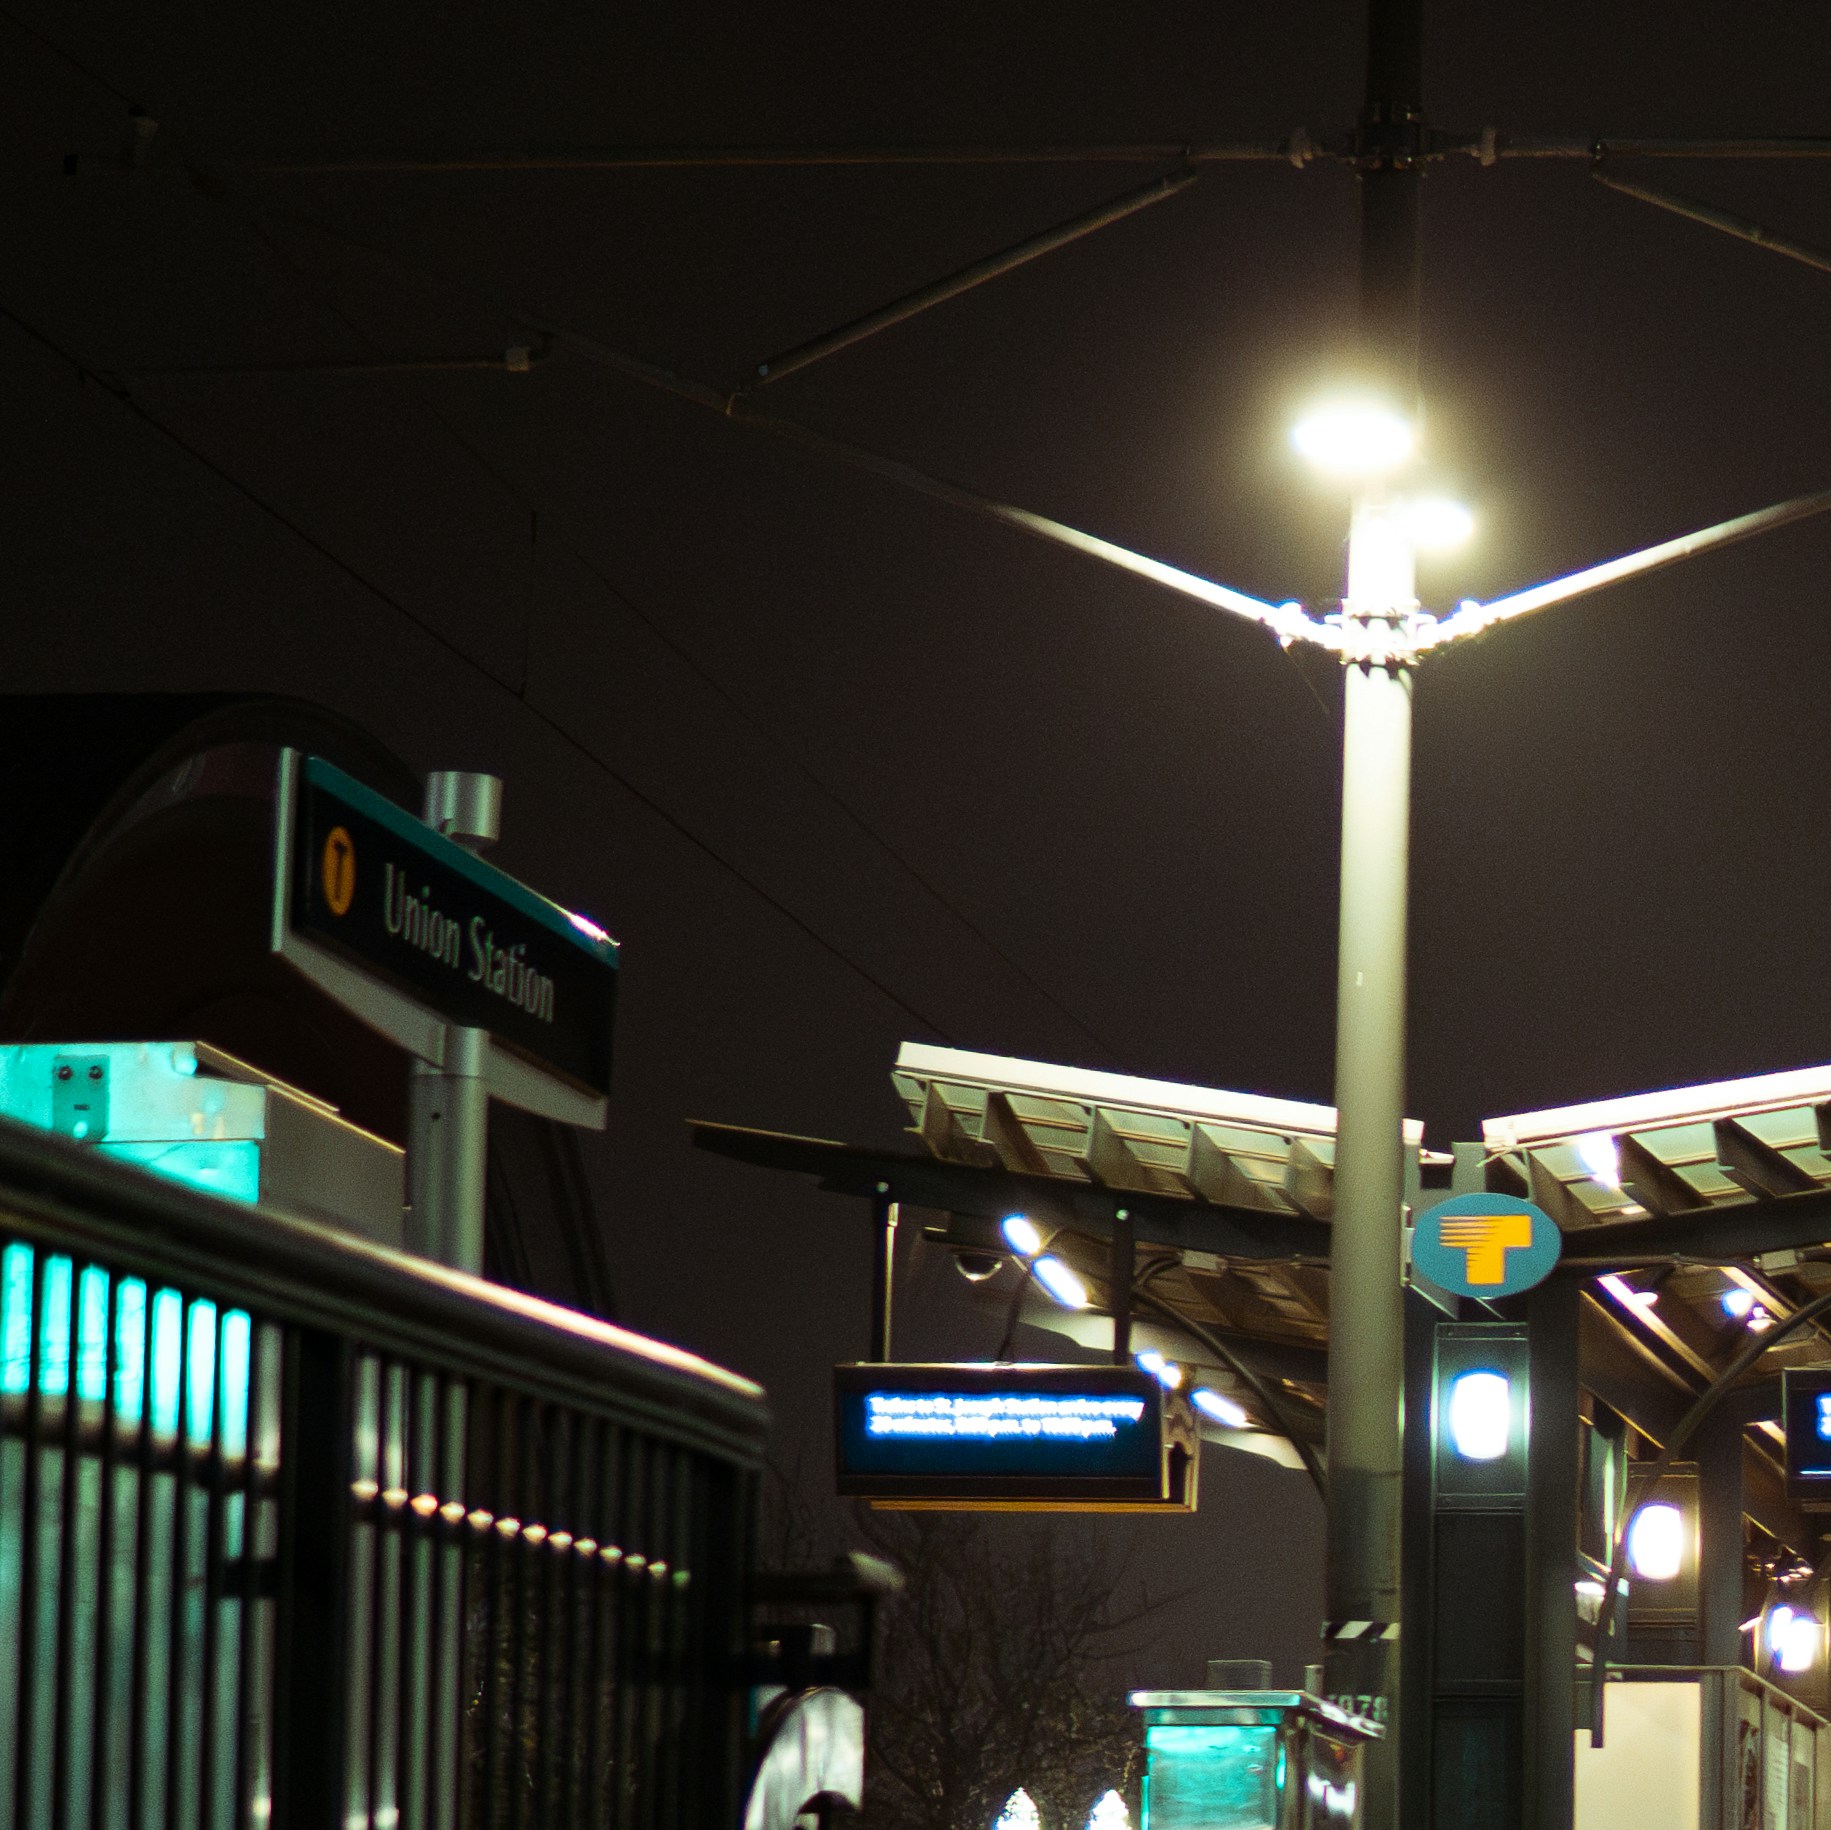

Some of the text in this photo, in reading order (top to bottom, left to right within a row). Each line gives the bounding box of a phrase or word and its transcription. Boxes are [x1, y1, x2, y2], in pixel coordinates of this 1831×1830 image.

[384, 861, 557, 1024] Union Station
[1440, 1214, 1532, 1285] T
